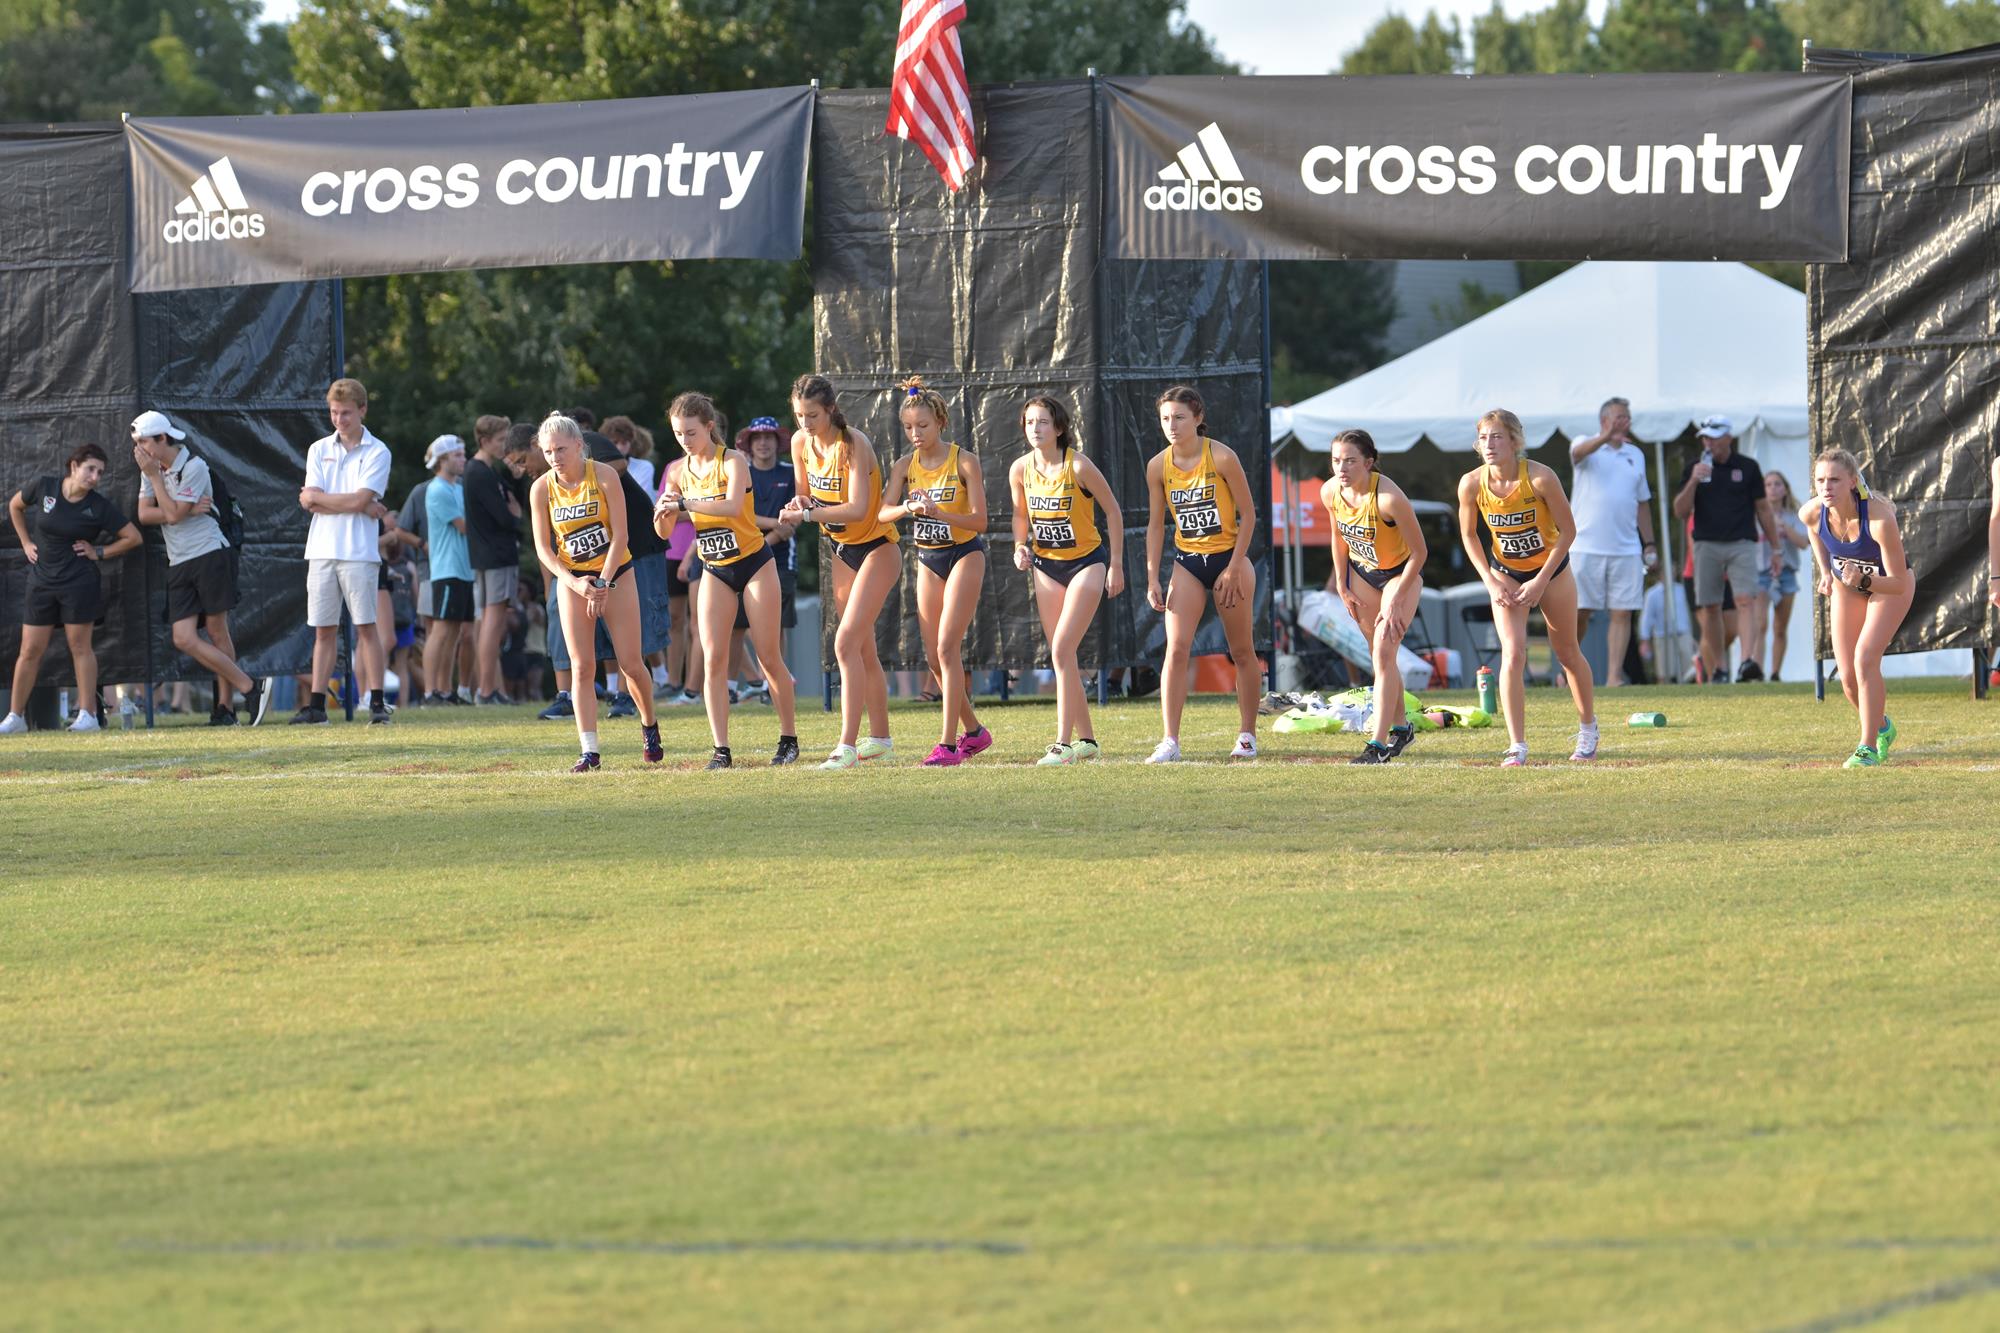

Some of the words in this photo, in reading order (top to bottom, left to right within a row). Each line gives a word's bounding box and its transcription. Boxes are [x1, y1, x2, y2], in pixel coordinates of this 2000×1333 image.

[301, 162, 480, 217] cross
[495, 143, 764, 210] country
[1300, 145, 1497, 195] cross
[1514, 133, 1803, 210] country
[1143, 179, 1263, 212] adidas
[163, 209, 265, 244] adidas
[1029, 496, 1072, 510] UNCG
[1170, 484, 1215, 504] UNCG
[554, 501, 598, 522] UNCG
[1179, 510, 1218, 529] 2932
[1488, 509, 1536, 527] UNCG
[916, 523, 950, 540] 2933
[1036, 525, 1072, 540] 2935
[570, 530, 606, 556] 2931
[699, 533, 735, 553] 2928
[1500, 535, 1541, 552] 2936
